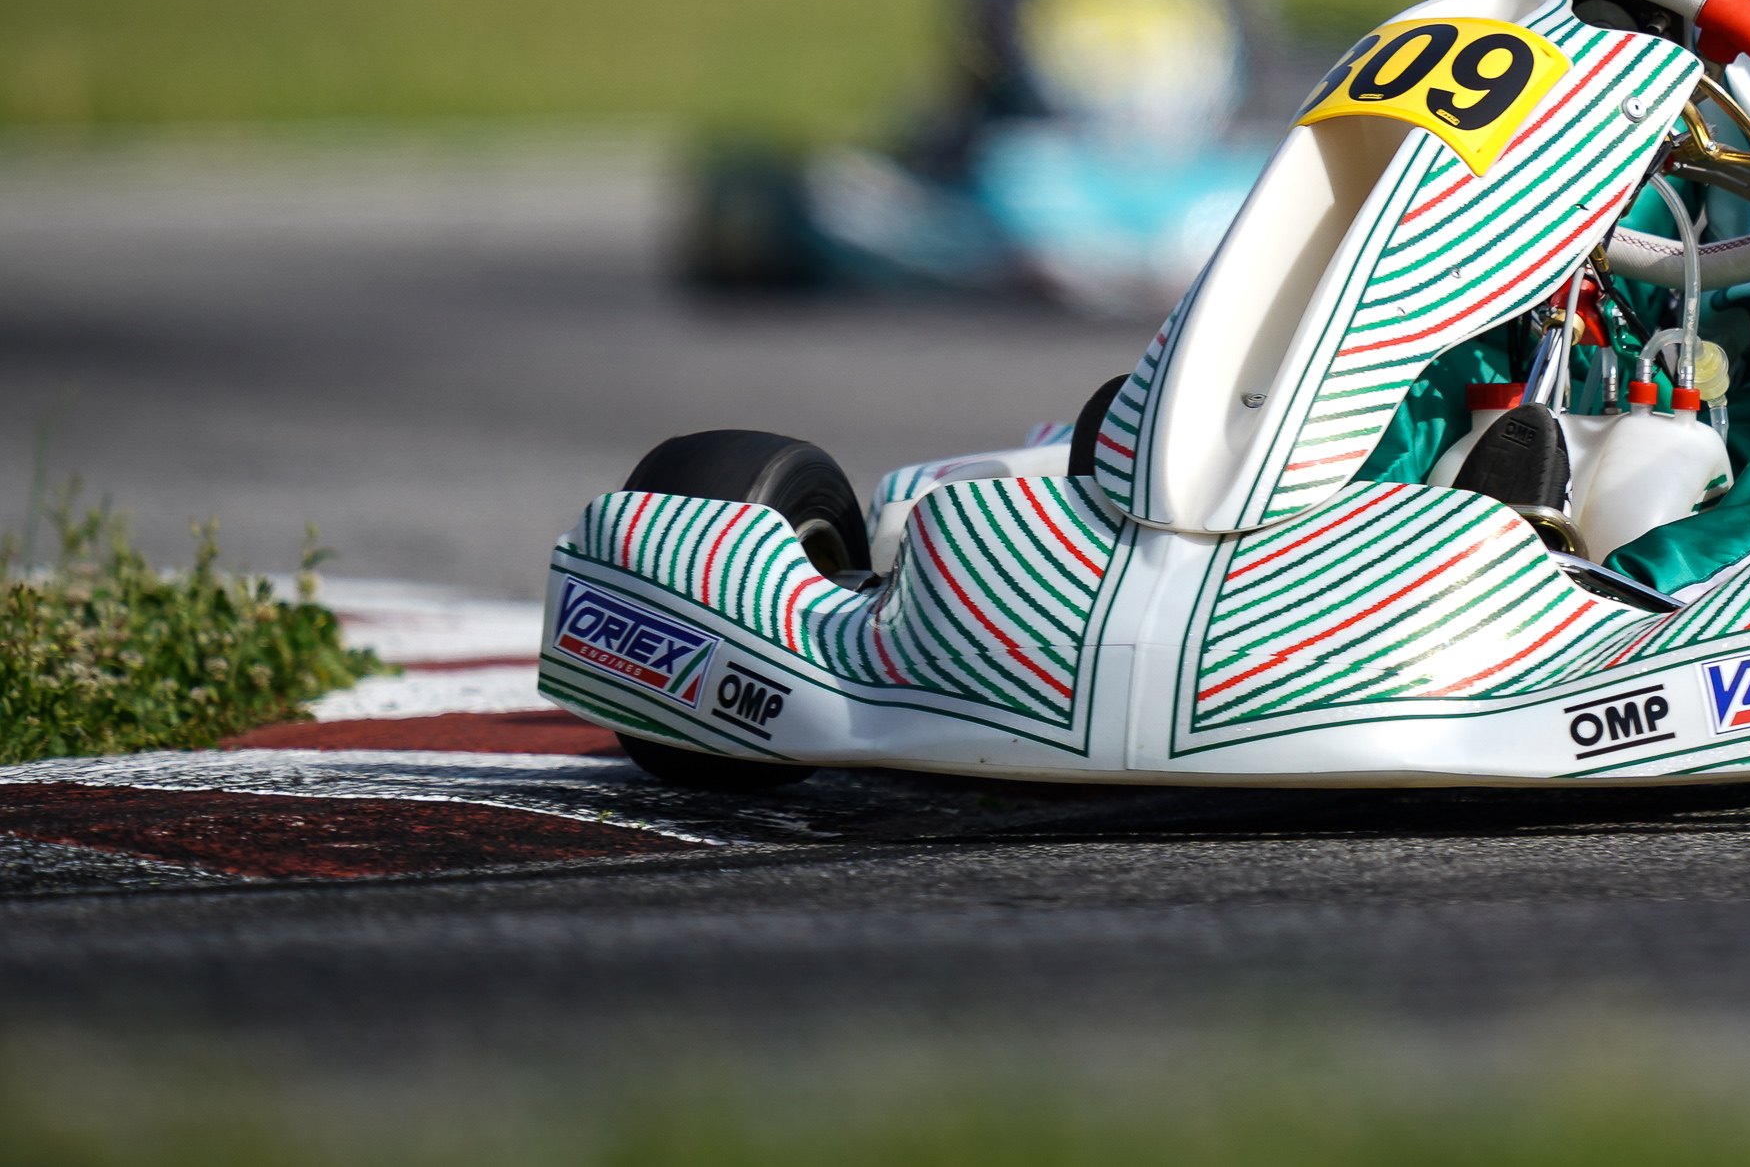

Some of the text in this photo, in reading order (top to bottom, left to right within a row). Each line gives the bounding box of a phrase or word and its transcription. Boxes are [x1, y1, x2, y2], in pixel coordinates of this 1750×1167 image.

[1300, 23, 1535, 131] 309
[556, 582, 712, 675] VORTEX
[579, 645, 643, 678] ENGINES
[717, 673, 784, 727] OMP
[1568, 694, 1670, 748] OMP
